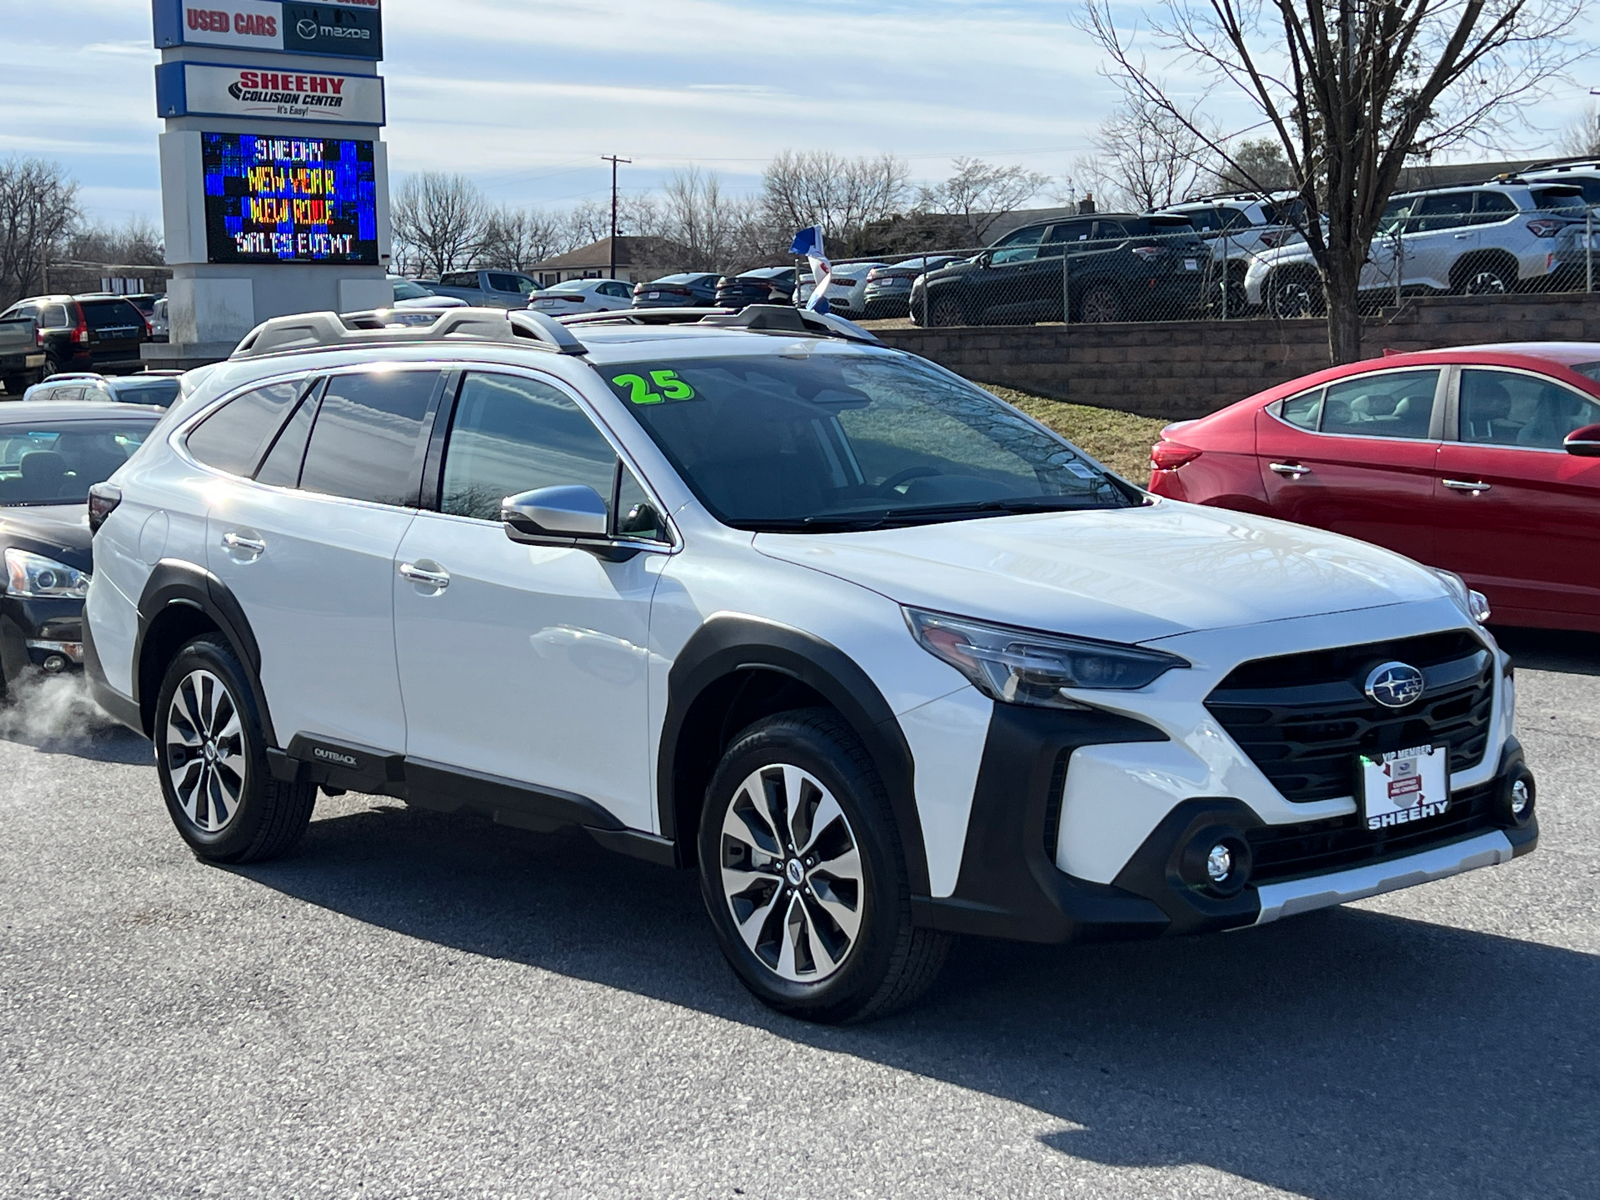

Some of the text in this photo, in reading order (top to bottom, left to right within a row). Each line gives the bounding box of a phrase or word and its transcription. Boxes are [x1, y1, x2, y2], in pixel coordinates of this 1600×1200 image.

[187, 8, 277, 37] USED CARS
[320, 25, 370, 39] mazda
[240, 71, 345, 94] SHEEHY
[241, 90, 343, 107] COLLISION CENTER
[277, 105, 309, 117] It's Easy!
[235, 231, 353, 254] SALES EVENT
[612, 369, 695, 405] 25
[314, 747, 357, 765] OUTBACK
[1382, 744, 1432, 762] VIP MEMBER
[1368, 801, 1449, 830] SHEEHY
